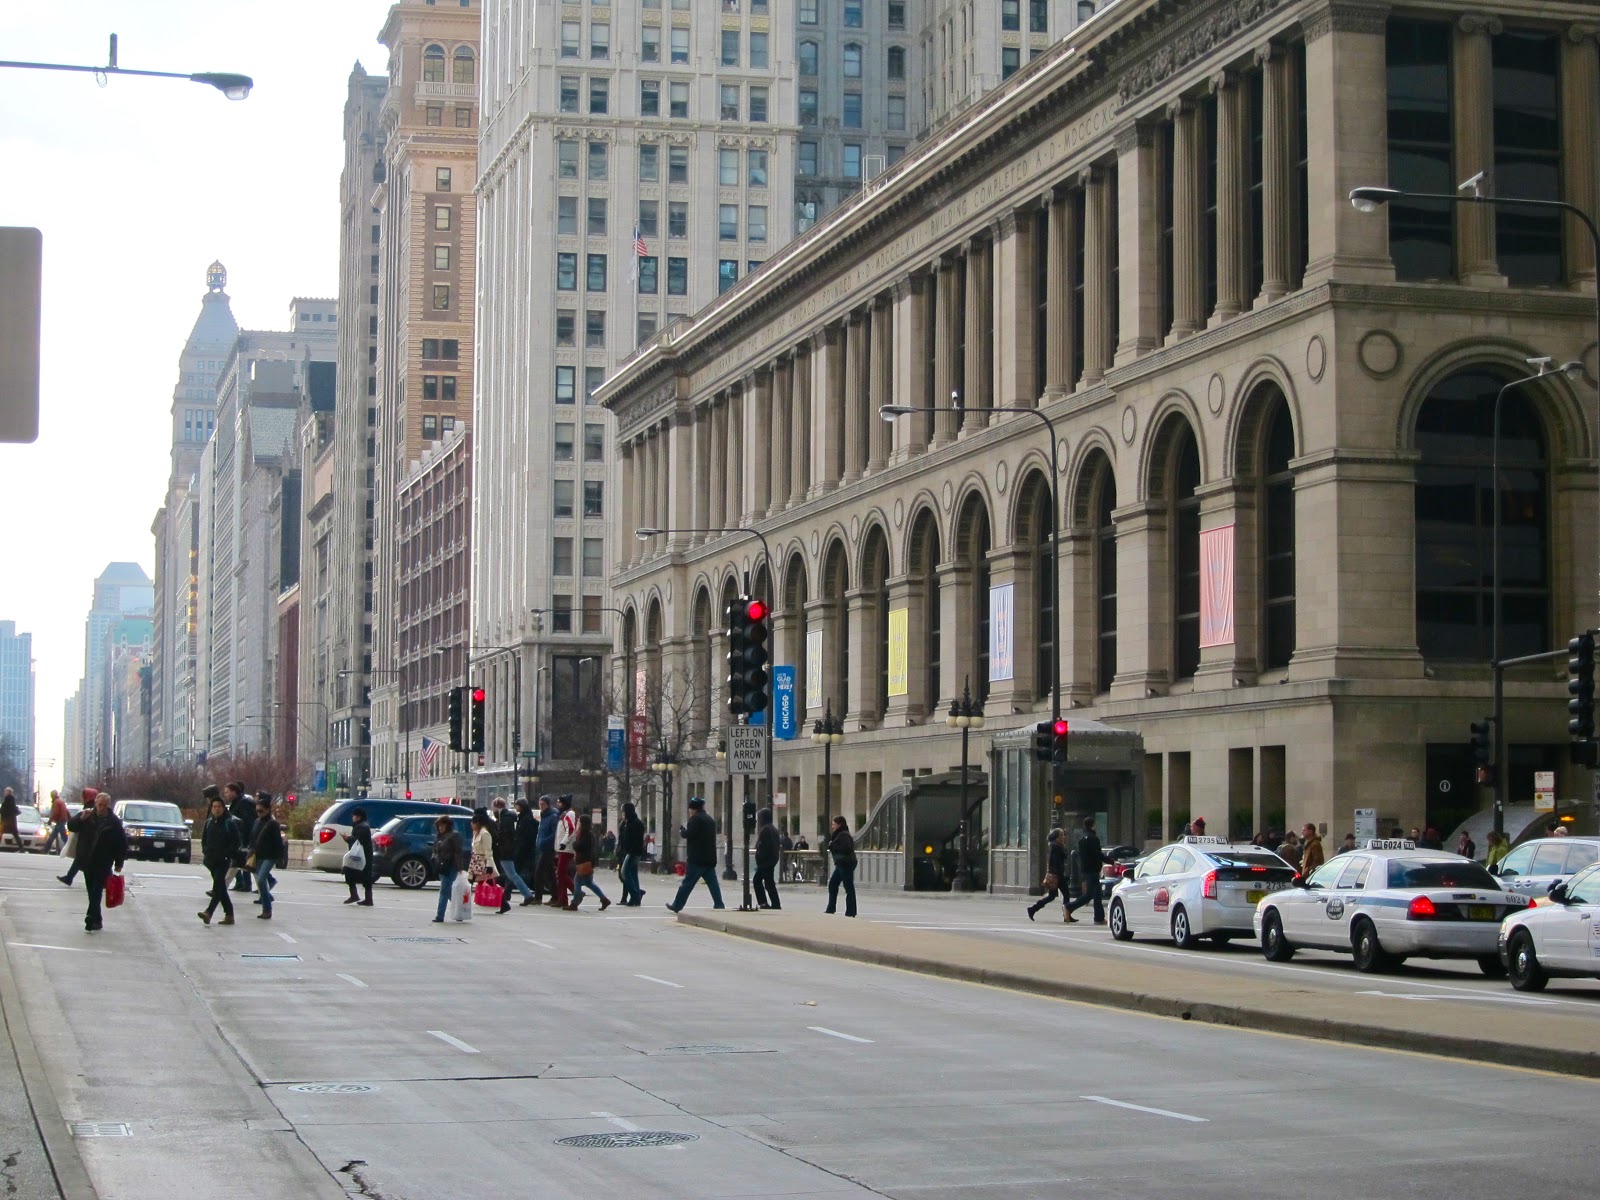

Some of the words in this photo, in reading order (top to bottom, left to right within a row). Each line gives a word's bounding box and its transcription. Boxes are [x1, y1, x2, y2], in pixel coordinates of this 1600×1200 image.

[973, 159, 1027, 208] COMPLETED
[782, 694, 790, 729] CHICAGO
[731, 728, 749, 738] LEFT
[753, 728, 764, 738] ON
[735, 740, 760, 749] GREEN
[734, 750, 761, 759] ARROW
[738, 761, 757, 770] ONLY
[1384, 841, 1402, 849] 6024
[1266, 882, 1286, 890] 2735
[1505, 895, 1526, 904] 6024
